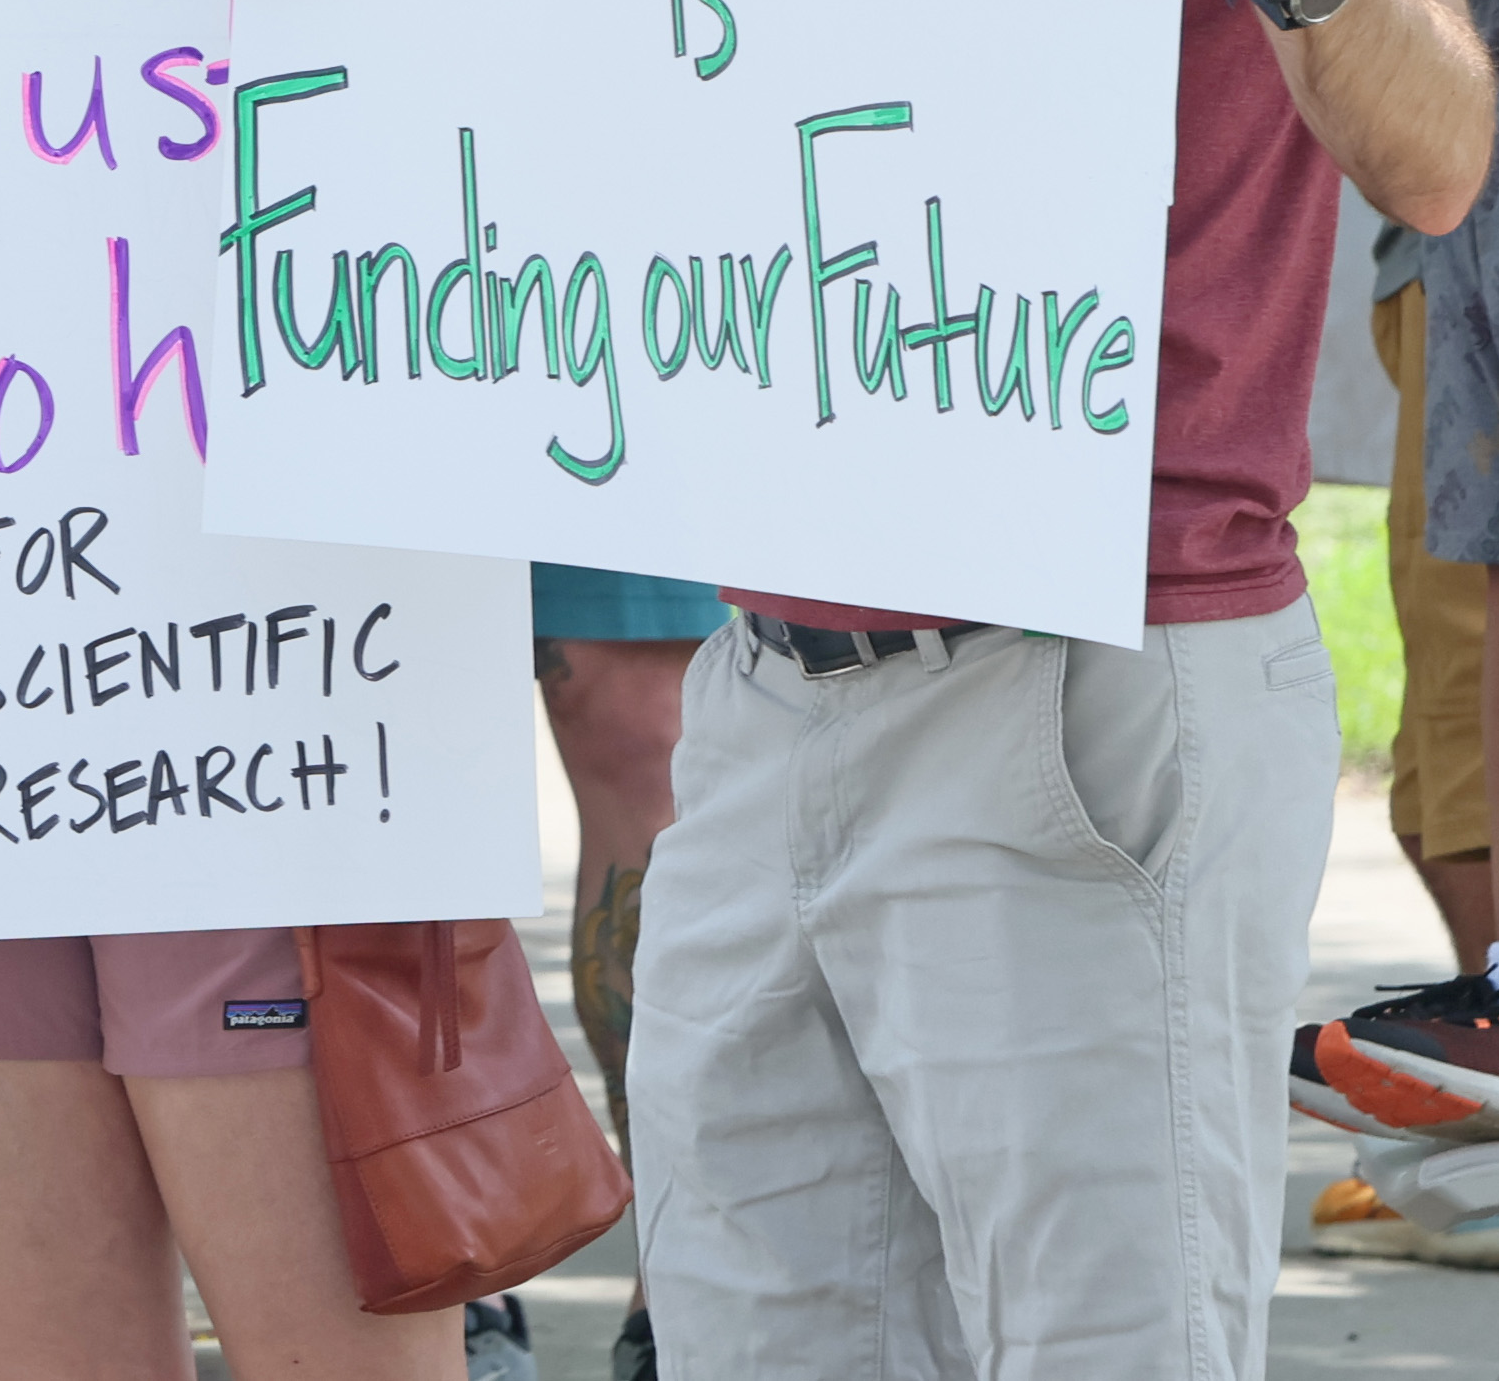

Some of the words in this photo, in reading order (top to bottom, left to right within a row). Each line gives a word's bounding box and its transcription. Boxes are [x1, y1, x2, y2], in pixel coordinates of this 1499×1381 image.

[217, 65, 627, 485] Funding
[642, 243, 793, 388] our
[796, 101, 1136, 435] Future
[229, 1014, 296, 1027] patagonia
